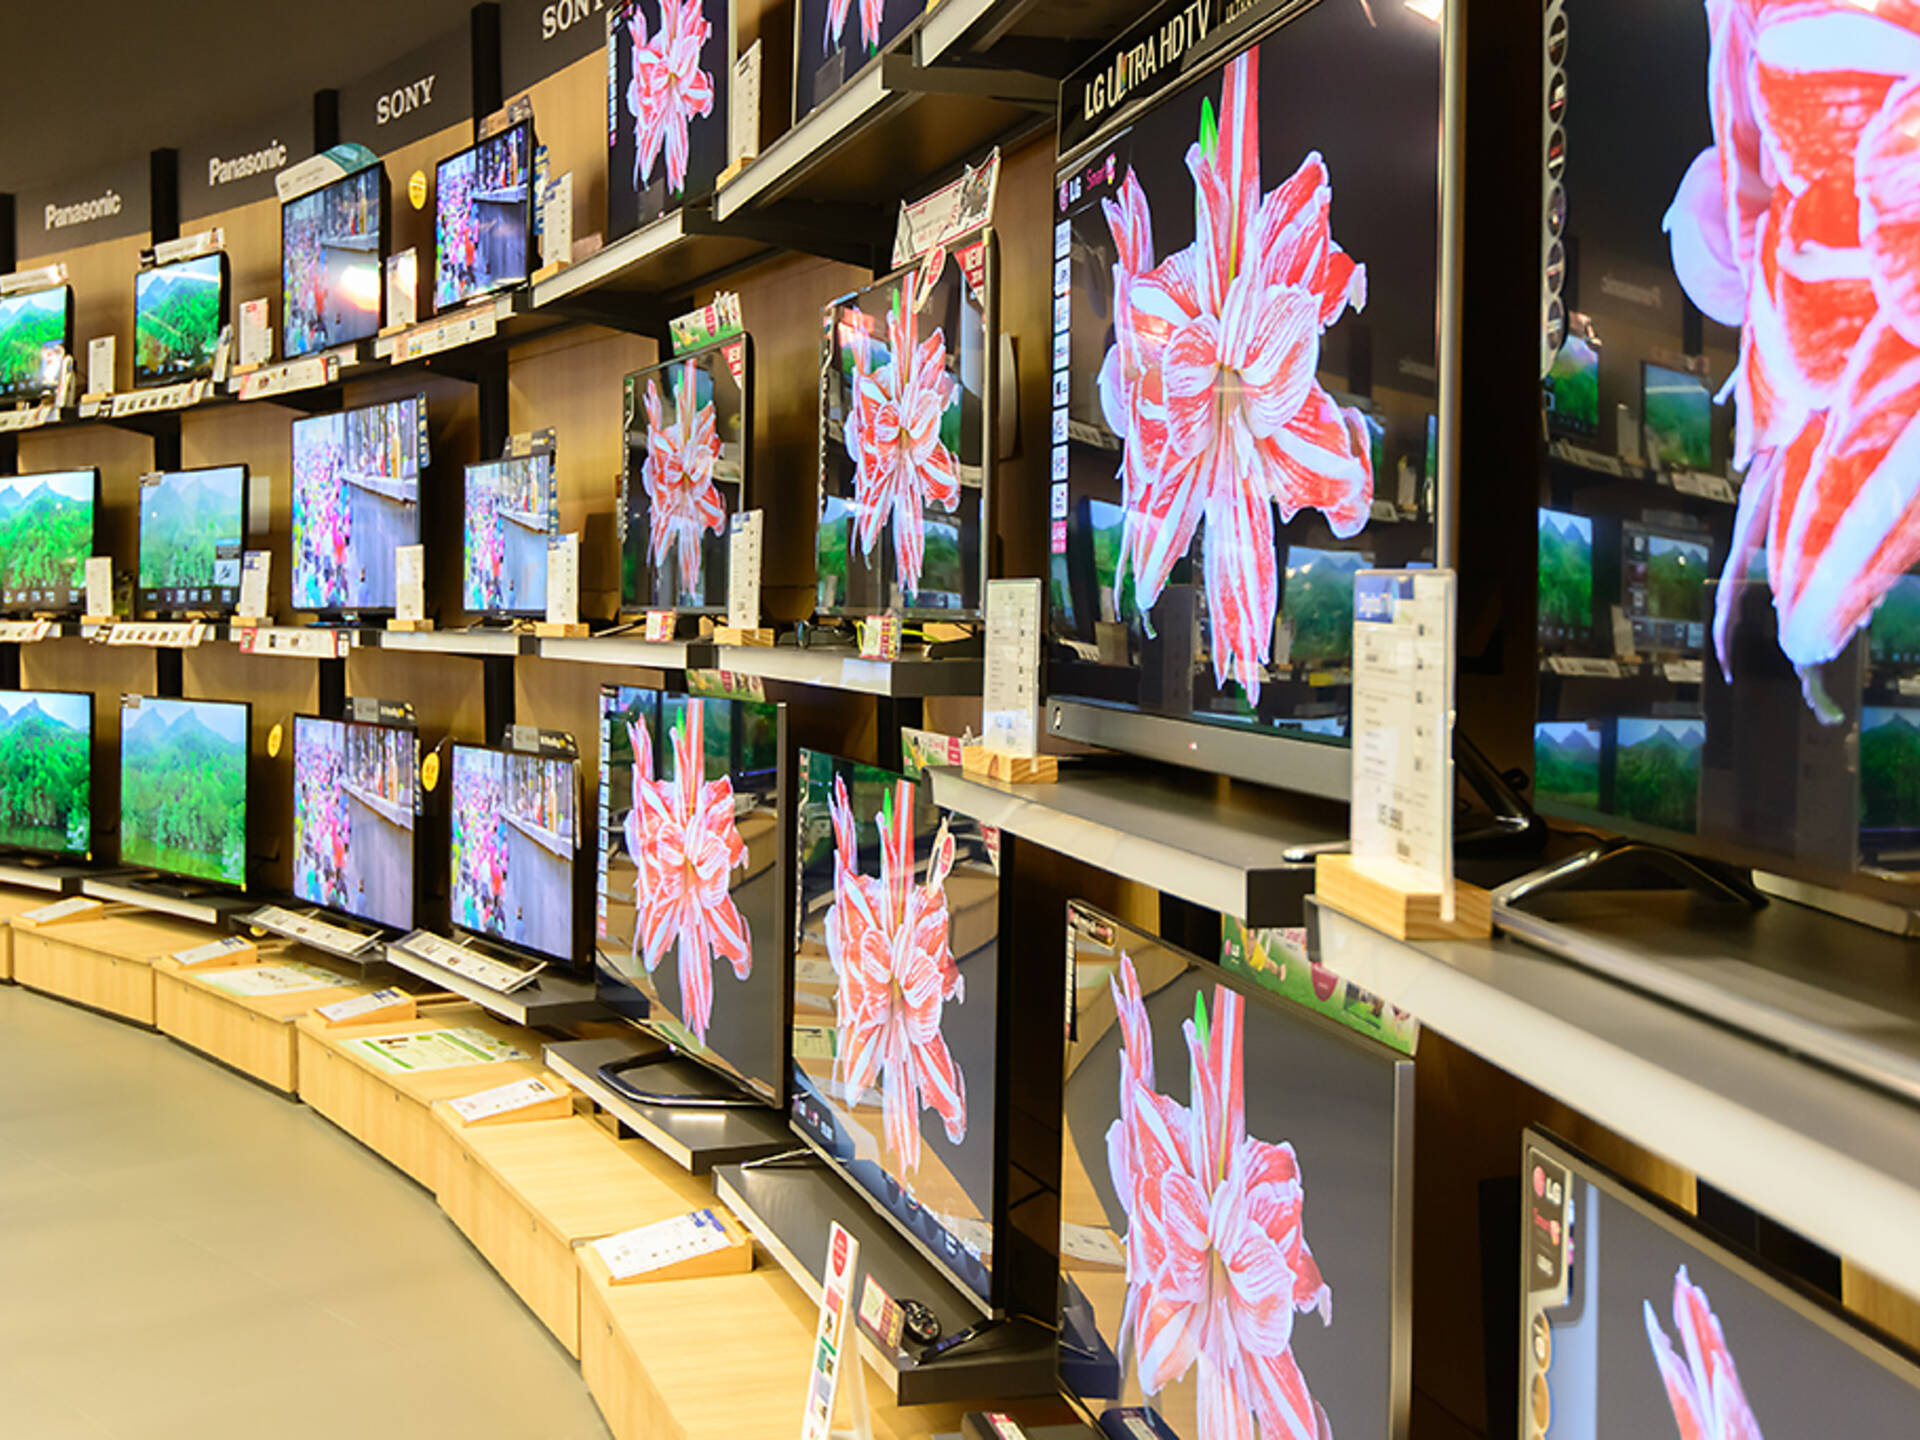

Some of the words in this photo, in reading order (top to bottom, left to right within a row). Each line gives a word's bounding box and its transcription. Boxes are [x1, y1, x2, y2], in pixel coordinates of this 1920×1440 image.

[1084, 73, 1105, 121] LG
[1107, 35, 1157, 108] ULTRA
[1160, 0, 1211, 68] HDTV
[376, 74, 436, 125] SONY
[209, 139, 287, 187] Panasonic
[44, 189, 121, 231] Panasonic
[1545, 1177, 1562, 1206] LG
